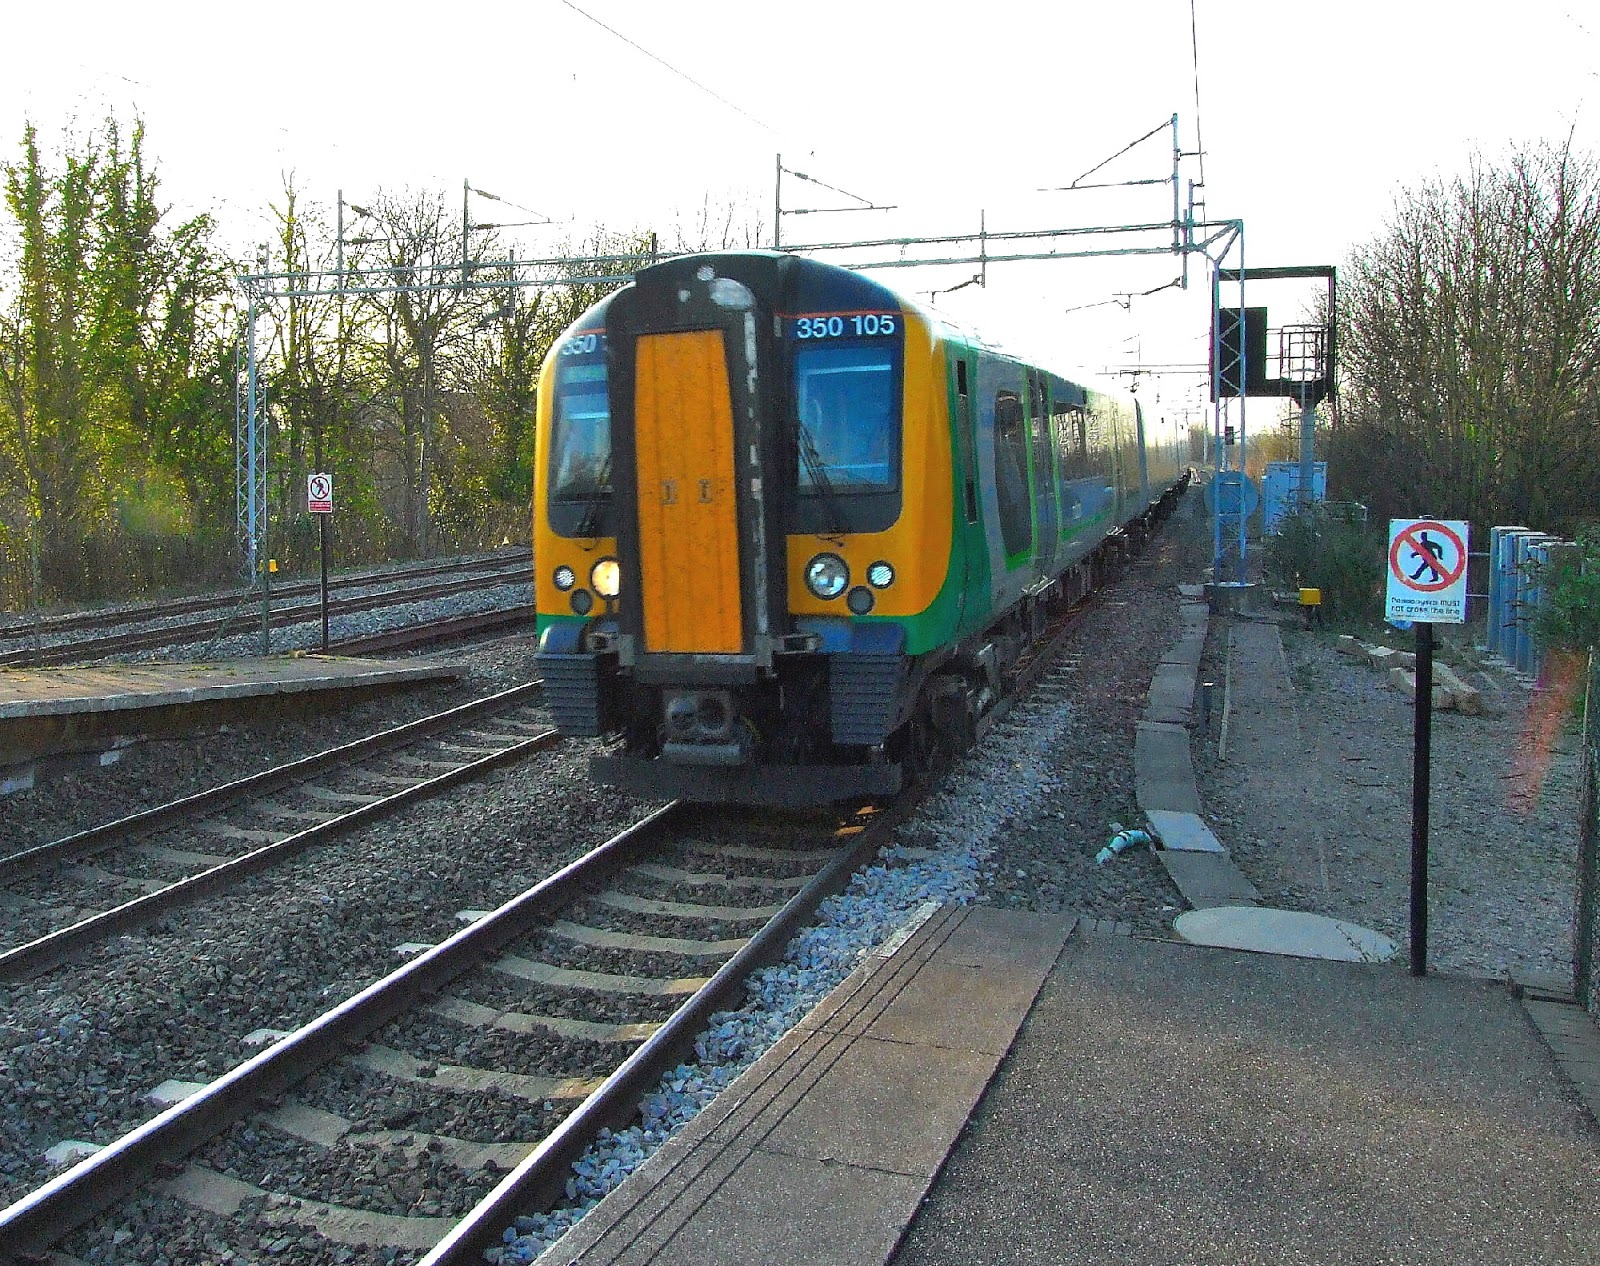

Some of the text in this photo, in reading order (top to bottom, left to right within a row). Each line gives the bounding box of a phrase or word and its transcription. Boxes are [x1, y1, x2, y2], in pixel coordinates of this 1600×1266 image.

[796, 314, 896, 339] 350 105
[562, 334, 597, 356] 350
